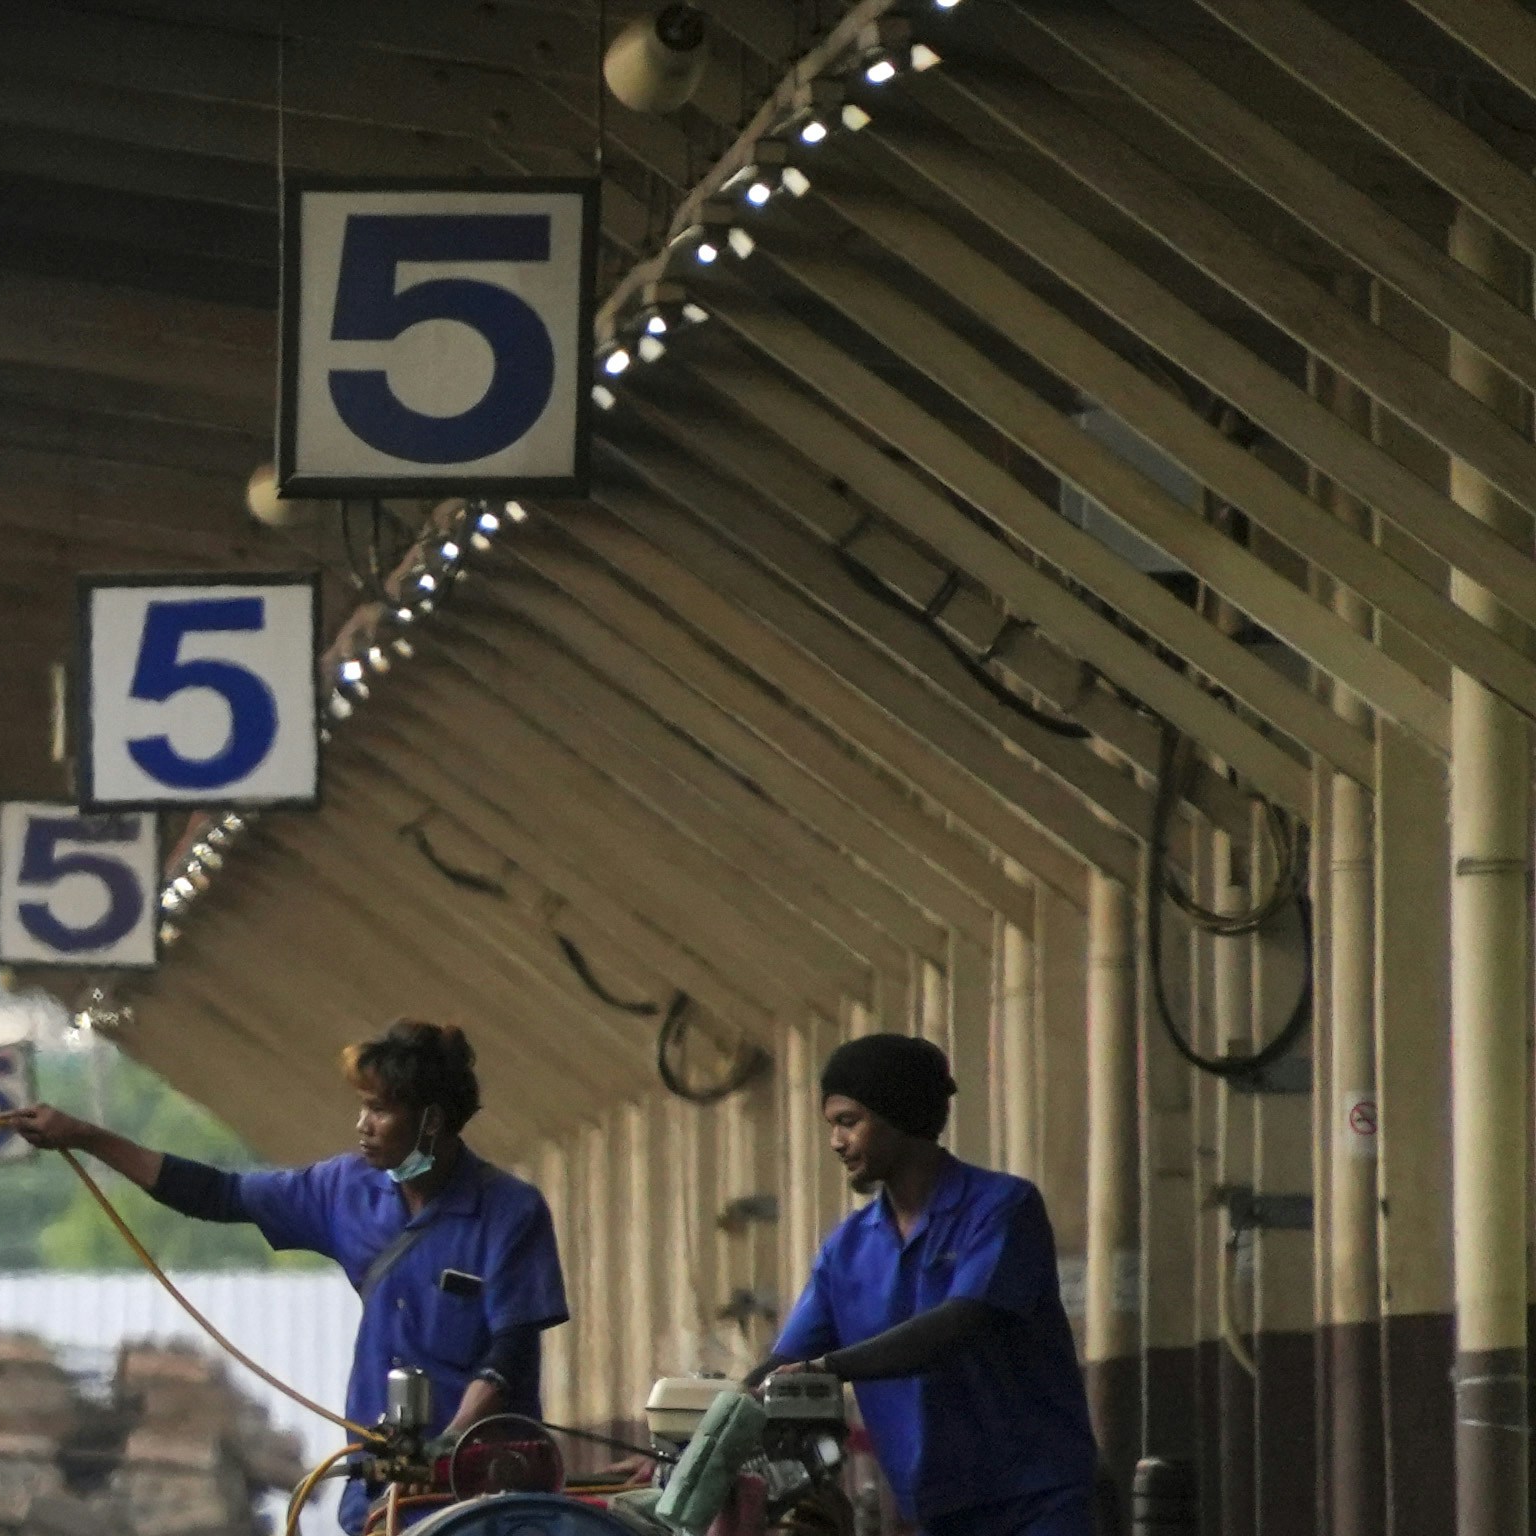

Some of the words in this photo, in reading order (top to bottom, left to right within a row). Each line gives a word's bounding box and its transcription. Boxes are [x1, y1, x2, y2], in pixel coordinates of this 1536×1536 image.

[328, 213, 555, 465] 5
[128, 596, 279, 790] 5
[18, 817, 145, 954] 5
